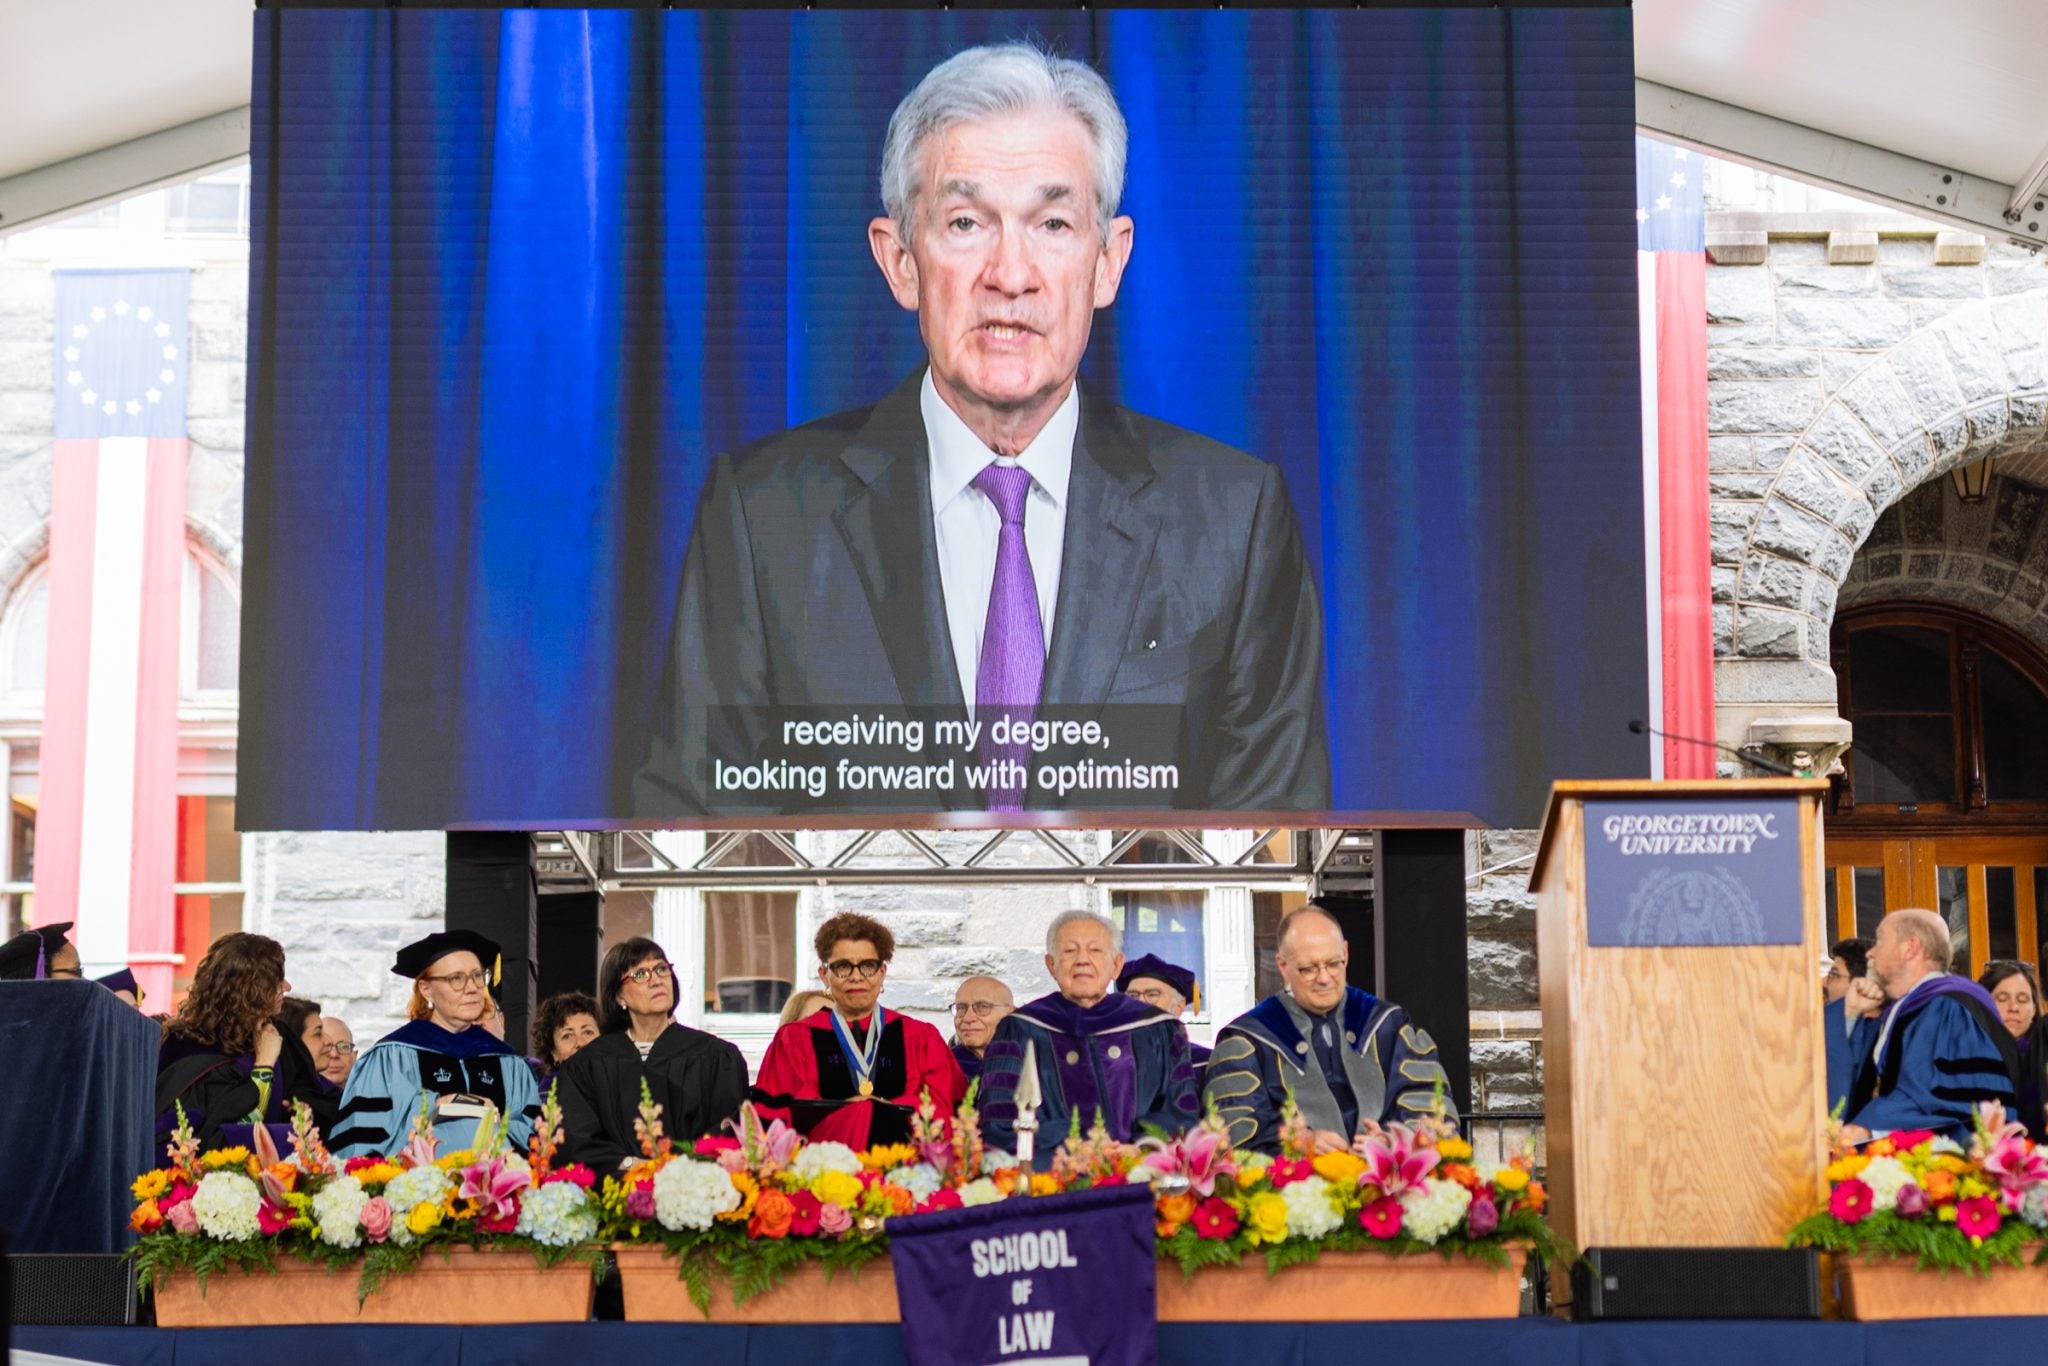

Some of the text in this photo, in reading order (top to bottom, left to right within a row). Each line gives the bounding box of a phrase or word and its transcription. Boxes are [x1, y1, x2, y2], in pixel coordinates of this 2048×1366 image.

[783, 714, 1110, 752] receiving my degree,
[714, 758, 1179, 796] looking forward with optimism
[1603, 813, 1778, 842] GEORGETOWN
[1620, 834, 1757, 855] UNIVERSITY
[970, 1229, 1077, 1277] SCHOOL
[1011, 1279, 1033, 1306] OF
[998, 1310, 1055, 1354] LAW
